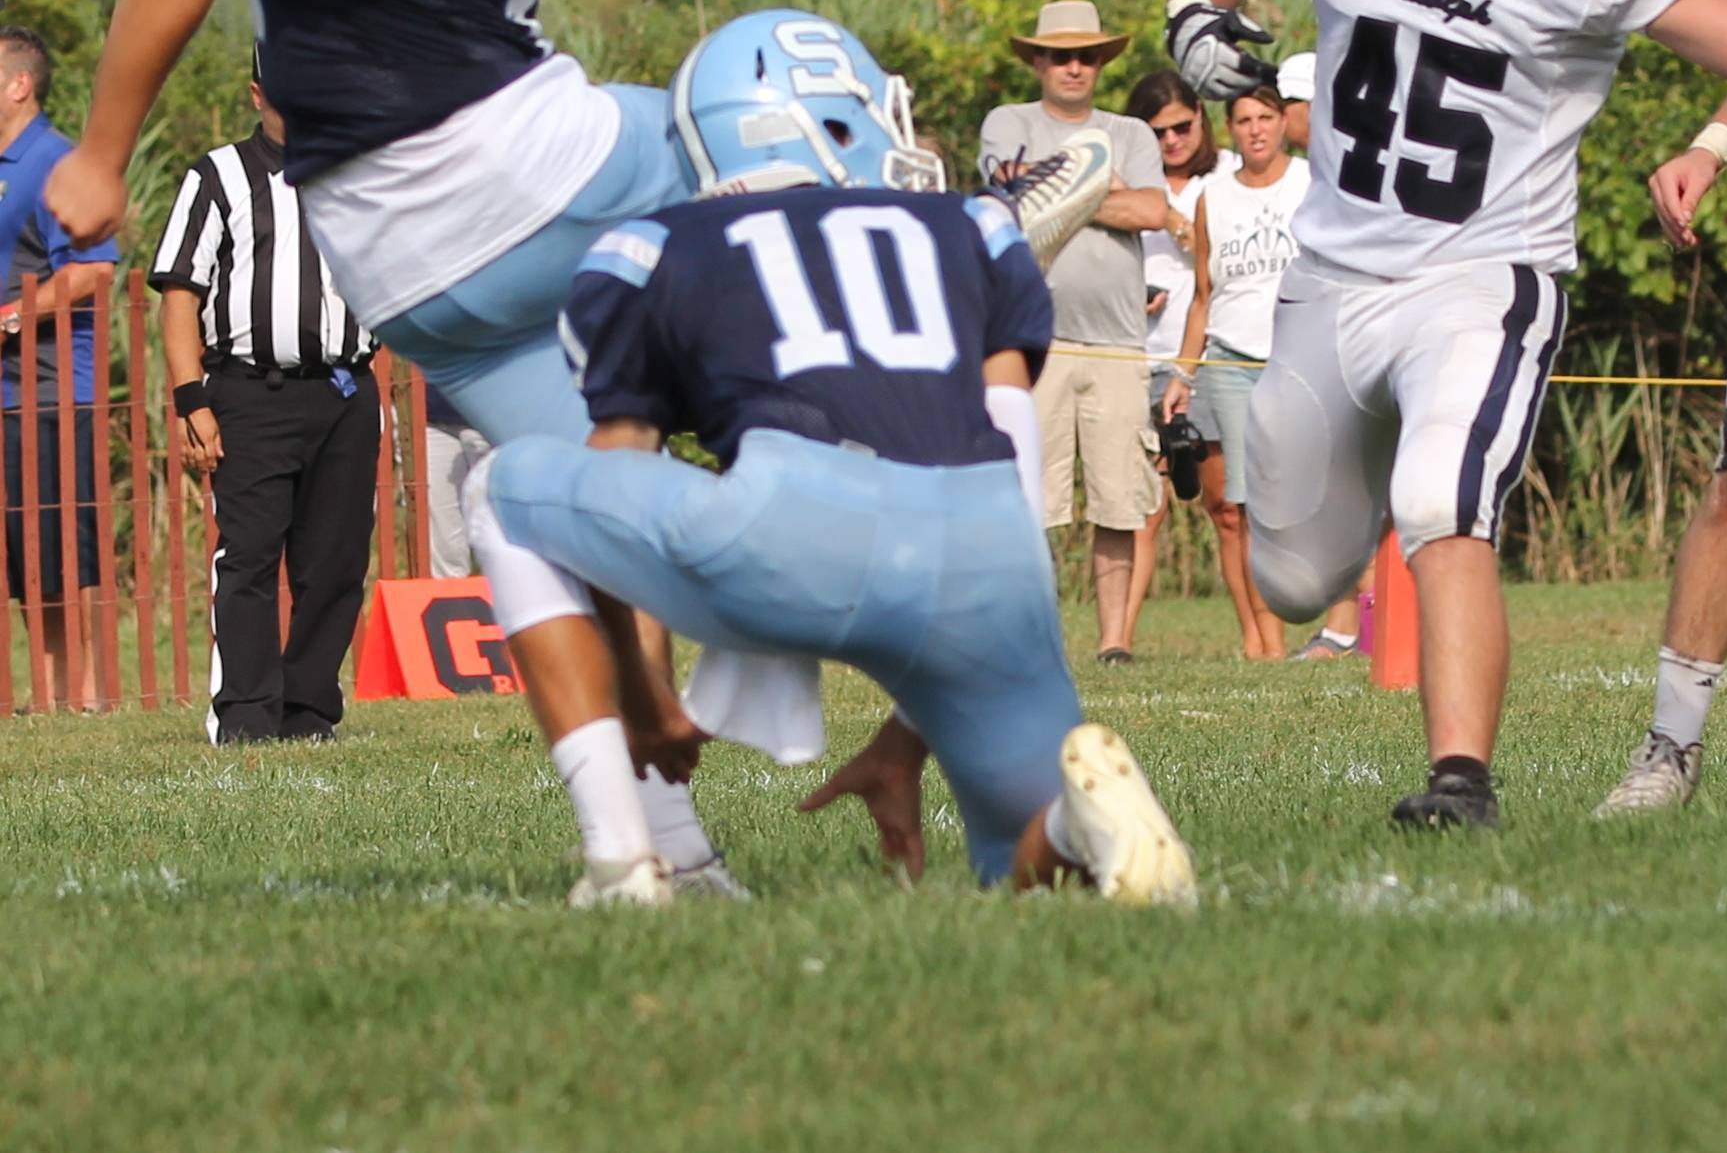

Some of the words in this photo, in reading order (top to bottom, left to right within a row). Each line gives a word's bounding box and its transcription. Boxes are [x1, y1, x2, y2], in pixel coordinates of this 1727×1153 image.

[772, 19, 853, 98] S
[1332, 15, 1510, 225] 45
[723, 205, 960, 382] 10
[421, 596, 515, 694] G
